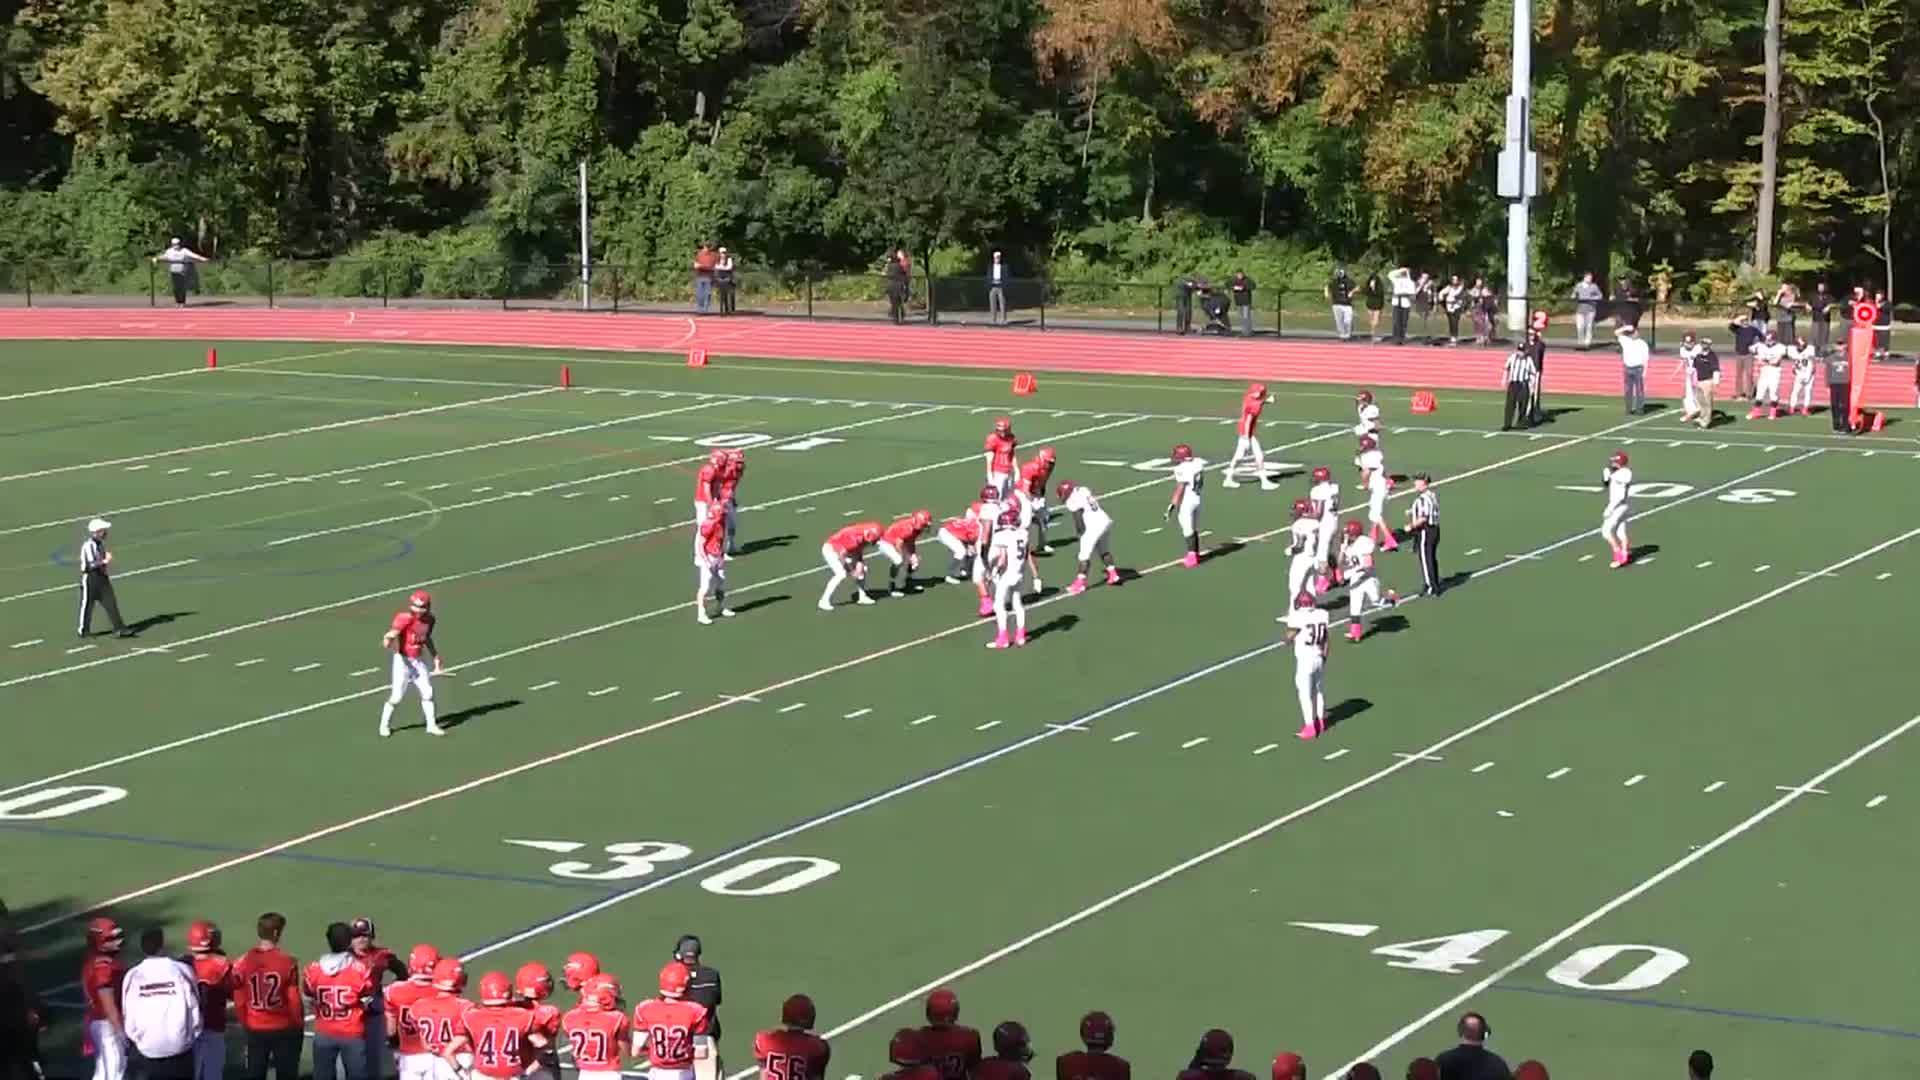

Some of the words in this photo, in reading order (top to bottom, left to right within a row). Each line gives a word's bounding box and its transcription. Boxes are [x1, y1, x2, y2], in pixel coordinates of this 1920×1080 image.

[1304, 623, 1327, 647] 30
[249, 970, 281, 1010] 12
[479, 1028, 520, 1067] 44
[569, 1029, 608, 1065] 27
[650, 1024, 689, 1061] 82
[767, 1052, 808, 1080] 56
